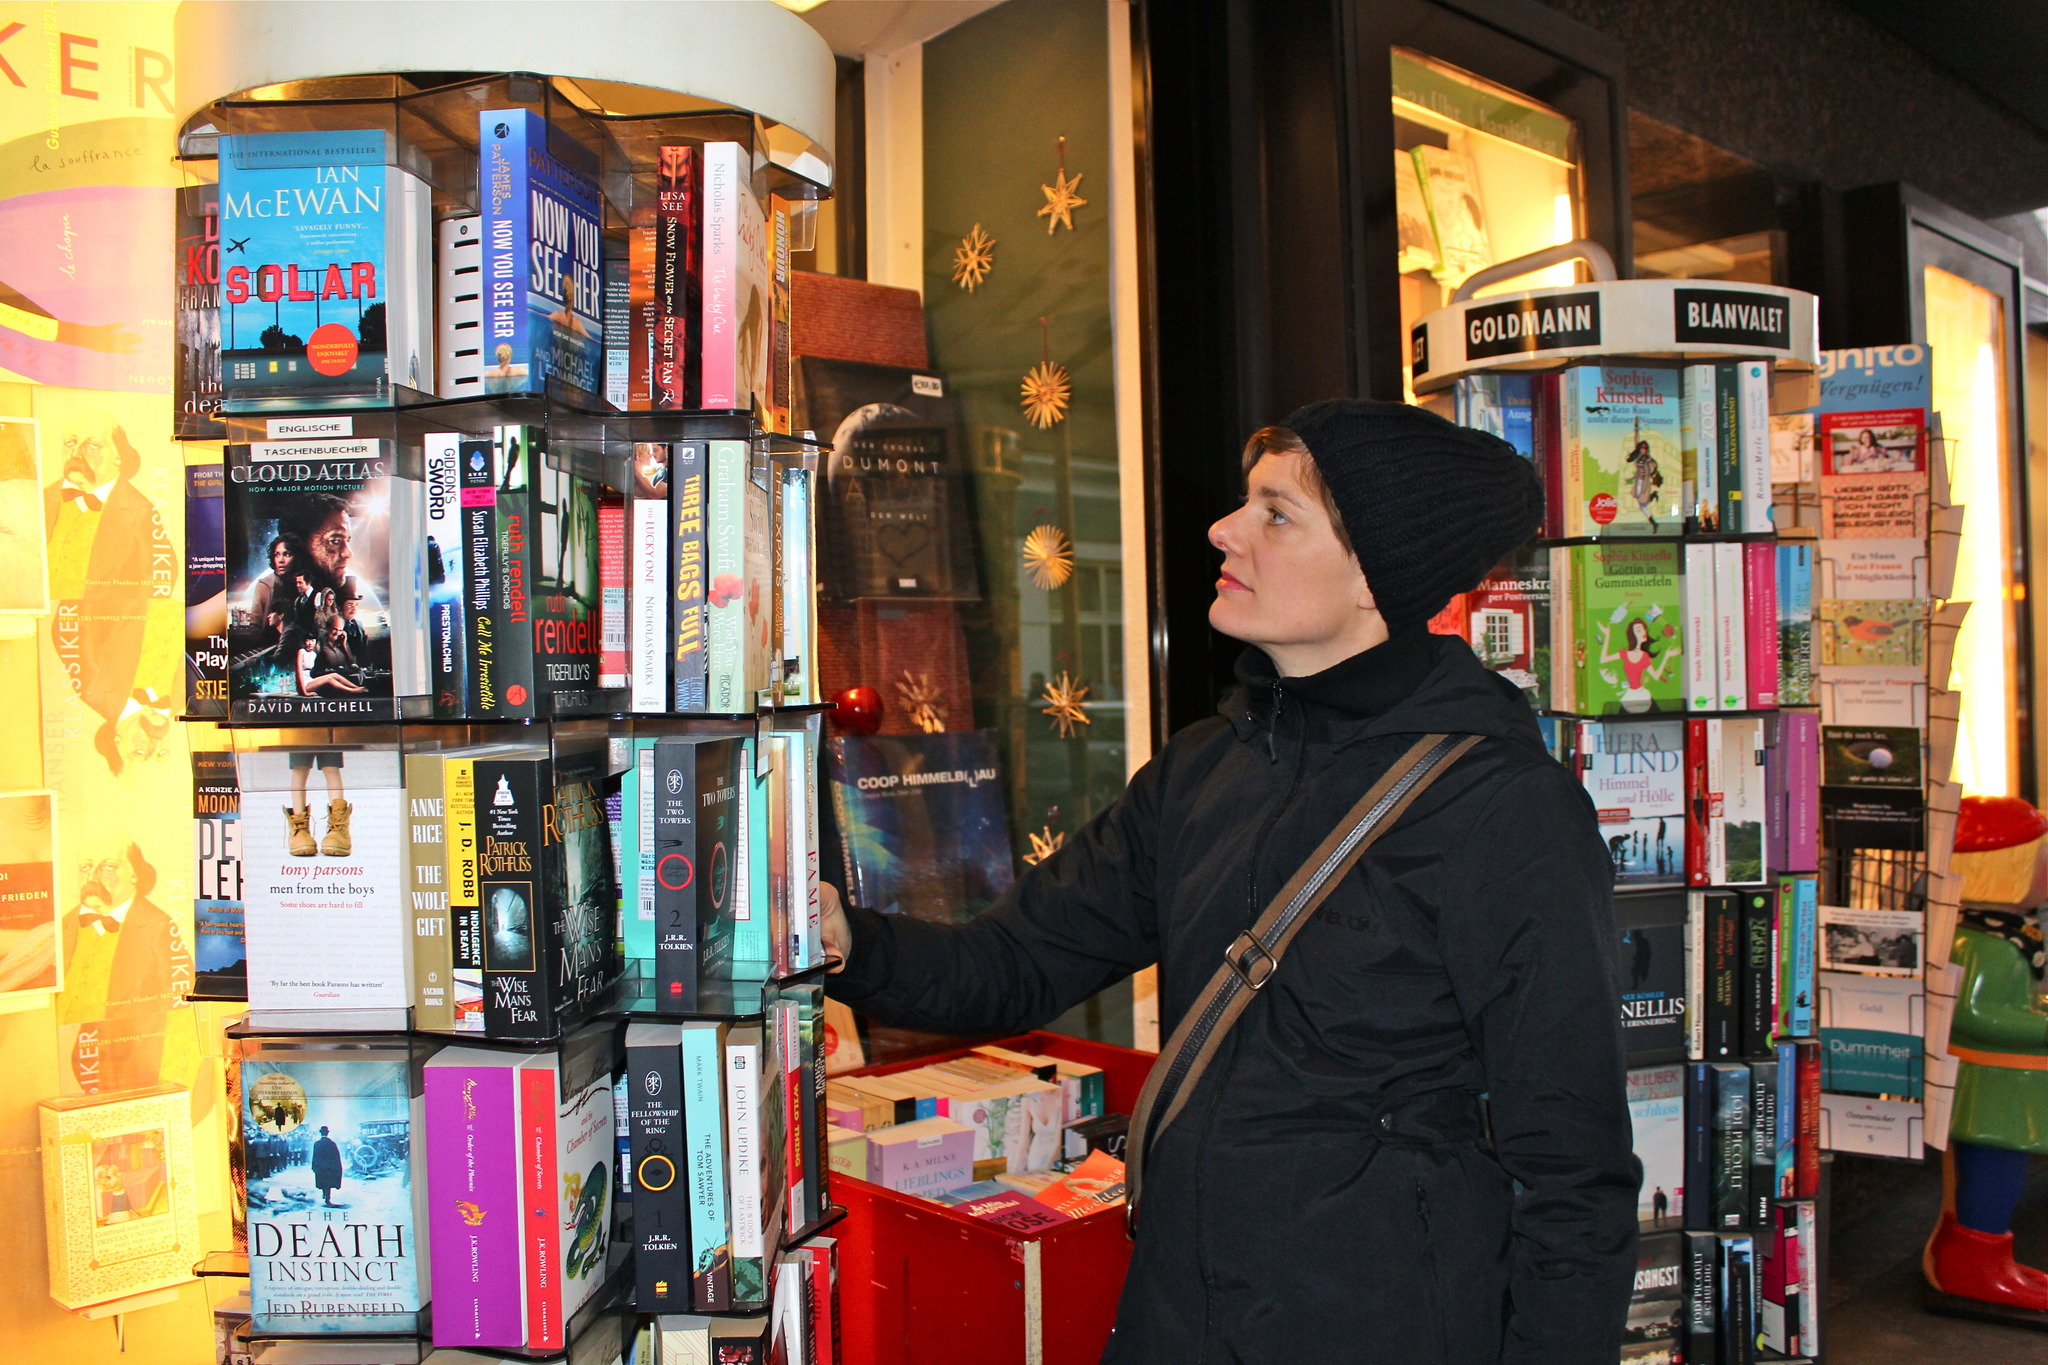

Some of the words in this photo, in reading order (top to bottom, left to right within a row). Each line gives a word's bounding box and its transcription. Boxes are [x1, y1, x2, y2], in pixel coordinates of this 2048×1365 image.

[316, 166, 359, 184] IAN
[491, 143, 502, 216] PATTERSON
[501, 158, 512, 200] JAMES
[528, 146, 598, 207] PATTERSON
[660, 191, 686, 201] LISA
[713, 163, 725, 215] Nicholas
[223, 186, 381, 220] McEWAN
[662, 202, 683, 211] SEE
[492, 219, 513, 249] NOW
[532, 189, 569, 247] NOW
[572, 211, 600, 271] YOU
[711, 217, 725, 255] Sparks
[775, 210, 785, 283] HONOUR
[493, 253, 513, 280] YOU
[226, 262, 376, 304] SOLAR
[531, 240, 564, 302] SEE
[572, 268, 600, 320] HER
[494, 282, 514, 307] SEE
[494, 309, 515, 339] HER
[1469, 304, 1592, 345] GOLDMANN
[1687, 302, 1783, 334] BLANVALET
[535, 348, 550, 362] AND
[551, 346, 595, 383] MICHAEL
[1606, 370, 1654, 389] Sophie
[1821, 375, 1924, 400] Vergnügen!
[1596, 386, 1664, 405] Kinsella
[279, 424, 341, 433] ENGLISCHE
[1729, 396, 1737, 466] AMAZONASKIND
[264, 446, 368, 457] TASCHENBUECHER
[853, 441, 875, 449] DER
[883, 443, 925, 452] GROSSE
[1755, 436, 1763, 463] Merle
[231, 464, 311, 483] CLOUD
[316, 461, 384, 480] ATLAS
[444, 448, 456, 503] GIDEON'S
[842, 456, 939, 474] DUMONT
[429, 459, 444, 520] SWORD
[716, 446, 735, 521] Graham
[1755, 468, 1764, 500] Robert
[1834, 485, 1874, 493] LIEBER
[678, 474, 701, 537] THREE
[1837, 493, 1872, 501] MACH
[1876, 492, 1909, 500] DASS
[151, 467, 172, 597] KLASSIKER
[472, 511, 487, 535] Susan
[508, 515, 527, 553] ruth
[473, 538, 488, 576] Elizabeth
[717, 524, 736, 571] Swift
[1593, 550, 1628, 564] Sophie
[1631, 551, 1672, 561] Kinsella
[678, 540, 701, 602] BAGS
[1609, 563, 1645, 575] Göttin
[1648, 563, 1657, 574] in
[473, 577, 489, 611] Phillips
[509, 558, 528, 623] rendell
[1594, 576, 1672, 589] Gummistiefeln
[1488, 594, 1502, 603] per
[535, 608, 598, 655] rendell
[677, 604, 700, 663] FULL
[58, 603, 82, 738] KLASSIKER
[546, 663, 590, 681] TIGERLILY'S
[1800, 631, 1811, 690] ROBERTS
[676, 677, 689, 710] SWANN
[690, 676, 703, 707] LEONIE
[720, 673, 731, 709] PICADOR
[248, 702, 293, 714] DAVID
[301, 701, 373, 713] MITCHELL
[1596, 729, 1661, 753] HERA
[1613, 751, 1679, 774] LIND
[857, 775, 899, 790] COOP
[1598, 776, 1650, 790] Himmel
[410, 798, 443, 818] ANNE
[1617, 792, 1637, 803] und
[1639, 788, 1674, 803] Hölle
[412, 825, 442, 844] RICE
[485, 836, 528, 857] PATRICK
[281, 863, 310, 879] tony
[313, 862, 364, 877] parsons
[416, 865, 441, 884] THE
[480, 853, 532, 876] ROTHFUSS
[1, 890, 49, 902] FRIEDEN
[270, 884, 294, 894] men
[296, 883, 325, 894] from
[327, 883, 346, 894] the
[348, 882, 375, 897] boys
[412, 891, 448, 910] WOLF
[416, 917, 445, 937] GIFT
[669, 910, 681, 928] 2
[166, 878, 191, 1008] KLASSIKER
[470, 910, 480, 966] INDULGENCE
[659, 943, 693, 951] TOLKIEN
[511, 1008, 538, 1024] FEAR
[1859, 1003, 1883, 1014] Geld
[1627, 1017, 1677, 1027] ERINNERUNG
[1830, 1039, 1911, 1058] Dummheit
[631, 1109, 679, 1118] FELLOWSHIP
[735, 1085, 747, 1122] JOHN
[1731, 1095, 1744, 1125] JODI
[1755, 1081, 1766, 1128] PICOULT
[1801, 1099, 1809, 1114] SEE
[1766, 1094, 1775, 1148] SCHULDIG
[1801, 1115, 1809, 1134] LISA
[736, 1127, 749, 1176] UPDIKE
[1755, 1130, 1766, 1156] JODI
[1731, 1131, 1744, 1189] PICOULT
[894, 1167, 965, 1192] LIEBLINGS
[306, 1211, 349, 1222] THE
[1759, 1197, 1767, 1219] PIPER
[252, 1222, 407, 1259] DEATH
[642, 1242, 678, 1251] TOLKIEN
[648, 1234, 671, 1242] J.R.R.
[268, 1261, 398, 1282] INSTINCT
[1693, 1253, 1703, 1298] PICOULT
[705, 1271, 714, 1304] VINTAGE
[1703, 1263, 1712, 1316] SCHULDIG
[1693, 1298, 1703, 1324] JODI
